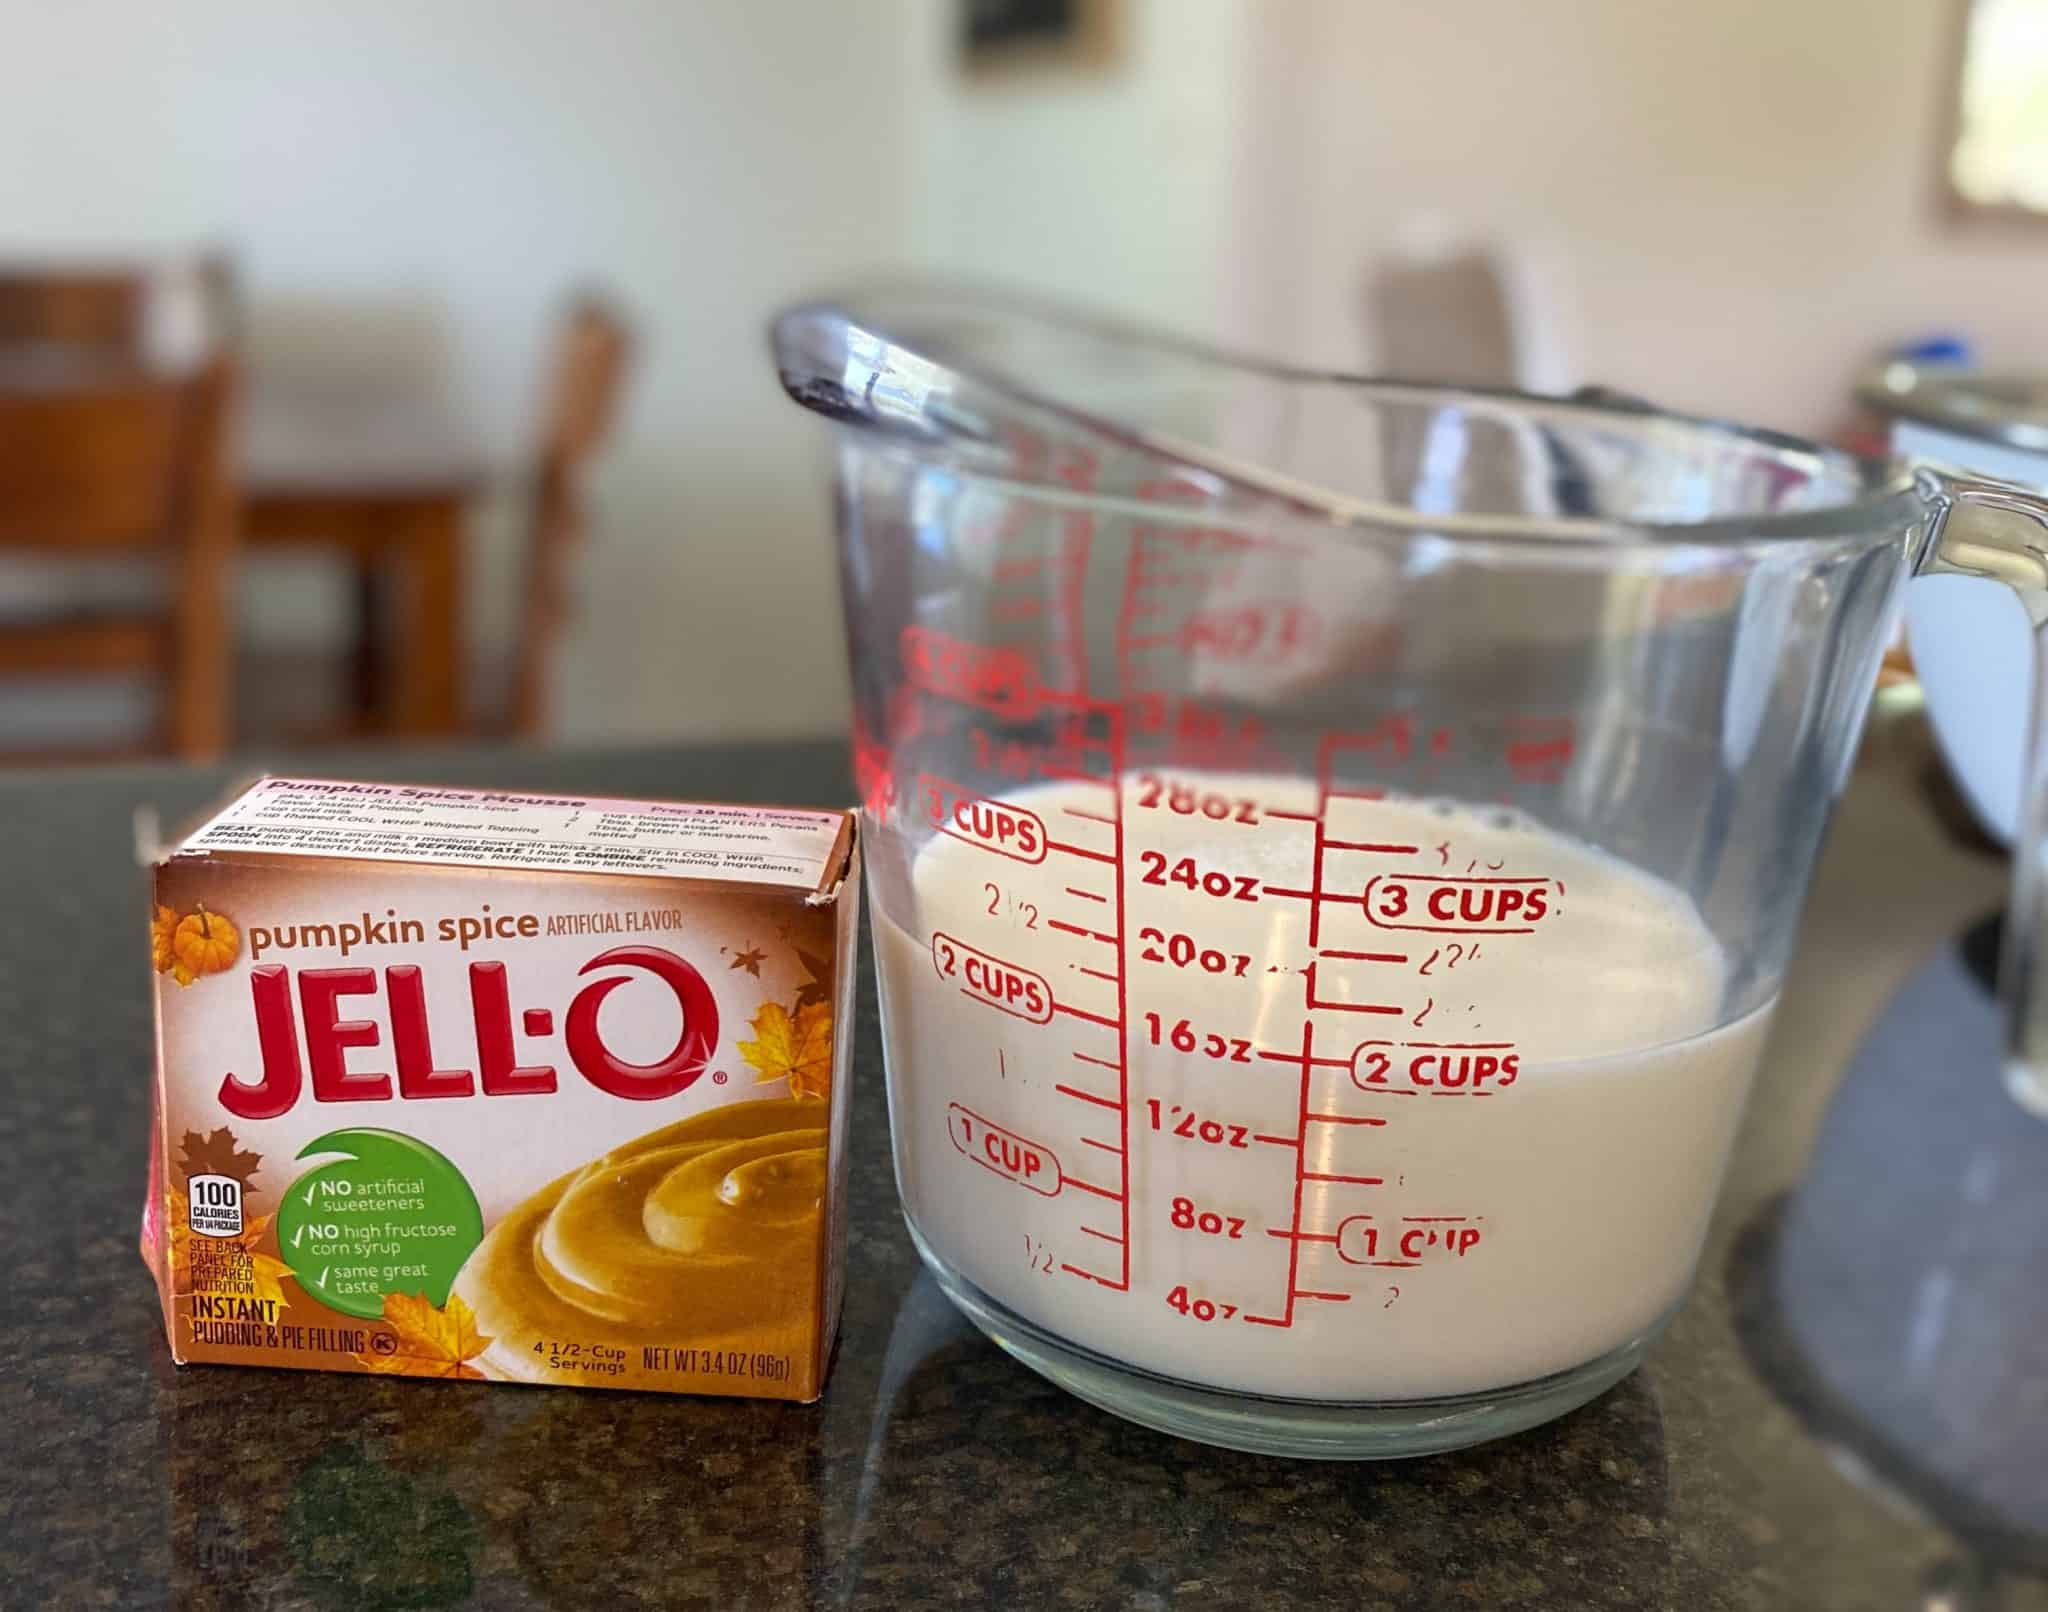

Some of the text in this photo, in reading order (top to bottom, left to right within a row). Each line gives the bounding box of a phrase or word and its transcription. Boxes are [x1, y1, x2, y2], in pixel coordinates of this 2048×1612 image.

[267, 781, 587, 808] Pumpkin Spice Mousse
[337, 815, 376, 824] COOL
[953, 799, 1037, 853] CUPS
[204, 831, 262, 840] SPOON
[413, 842, 527, 856] REFRIGERATE
[574, 850, 649, 863] COMBINE
[650, 856, 720, 868] remaining
[213, 825, 256, 833] BEAT
[258, 827, 314, 837] pudding
[681, 851, 721, 861] COOL
[1139, 850, 1260, 902] 24oz
[1379, 884, 1548, 922] 3 CUPS
[249, 904, 683, 961] pumpkin spice ARTIFICIAL FLAVOR
[941, 944, 1044, 1014] 2 CUPS
[1365, 1052, 1520, 1087] 2 CUPS
[1146, 1098, 1249, 1149] 12oz
[961, 1117, 1041, 1178] 1 CUP
[195, 1180, 237, 1208] 100
[320, 1178, 425, 1197] NO artificial
[193, 1206, 240, 1220] CALORIES
[323, 1198, 425, 1213] sweeteners
[1170, 1196, 1246, 1239] 8oz
[308, 1222, 457, 1243] NO high fructose
[1363, 1228, 1378, 1257] 1
[190, 1239, 248, 1256] SEE BACK
[190, 1252, 255, 1269] PANEL FOR
[311, 1242, 401, 1259] corn syrup
[190, 1266, 254, 1281] PREPARED
[333, 1263, 429, 1281] same great
[191, 1279, 255, 1295] NUTRITION
[335, 1281, 379, 1295] taste
[192, 1296, 276, 1322] INSTANT
[193, 1320, 365, 1354] PUDDING & PIE FILLING
[533, 1341, 627, 1363] 4 1/2-Cup
[642, 1347, 791, 1383] NET WT 3.4 OZ (96g)
[550, 1356, 627, 1376] Servings
